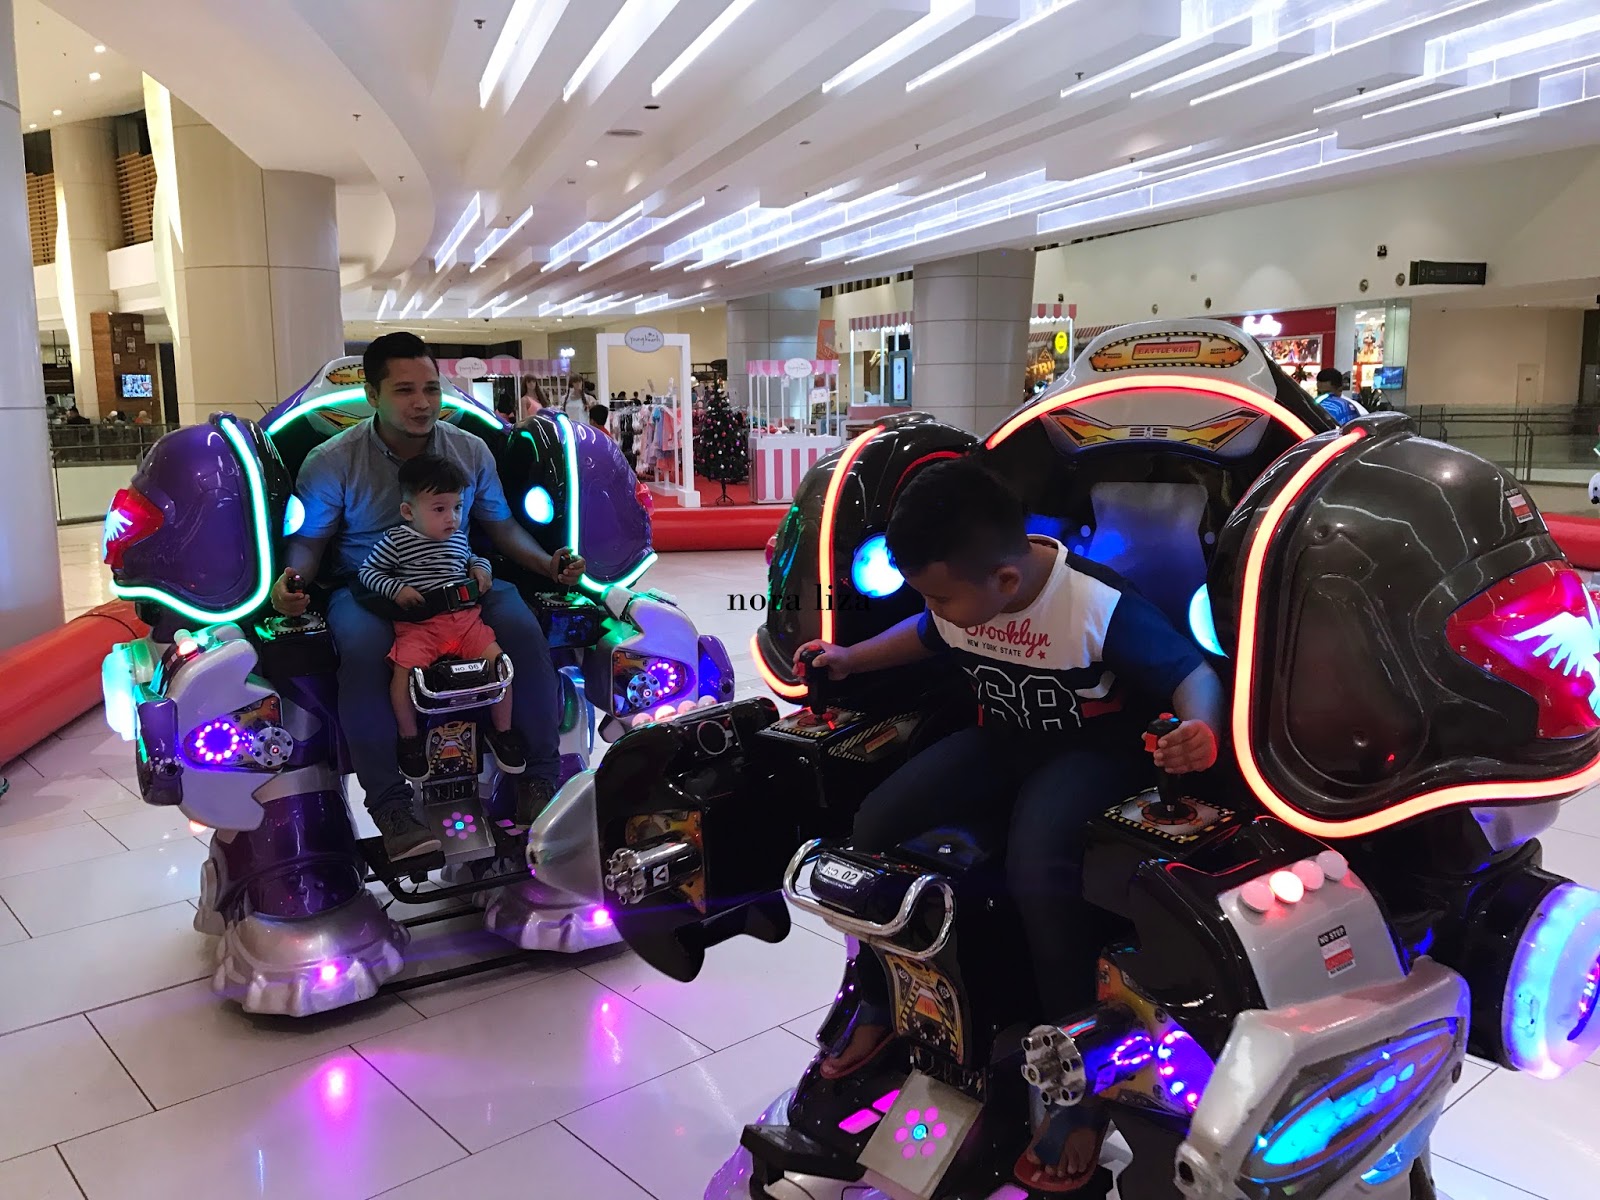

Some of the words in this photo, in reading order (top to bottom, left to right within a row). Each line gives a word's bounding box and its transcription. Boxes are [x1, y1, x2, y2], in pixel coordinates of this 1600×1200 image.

[967, 638, 979, 648] NEW
[982, 642, 998, 653] YORK
[1000, 647, 1022, 658] STATE
[841, 870, 858, 882] 02
